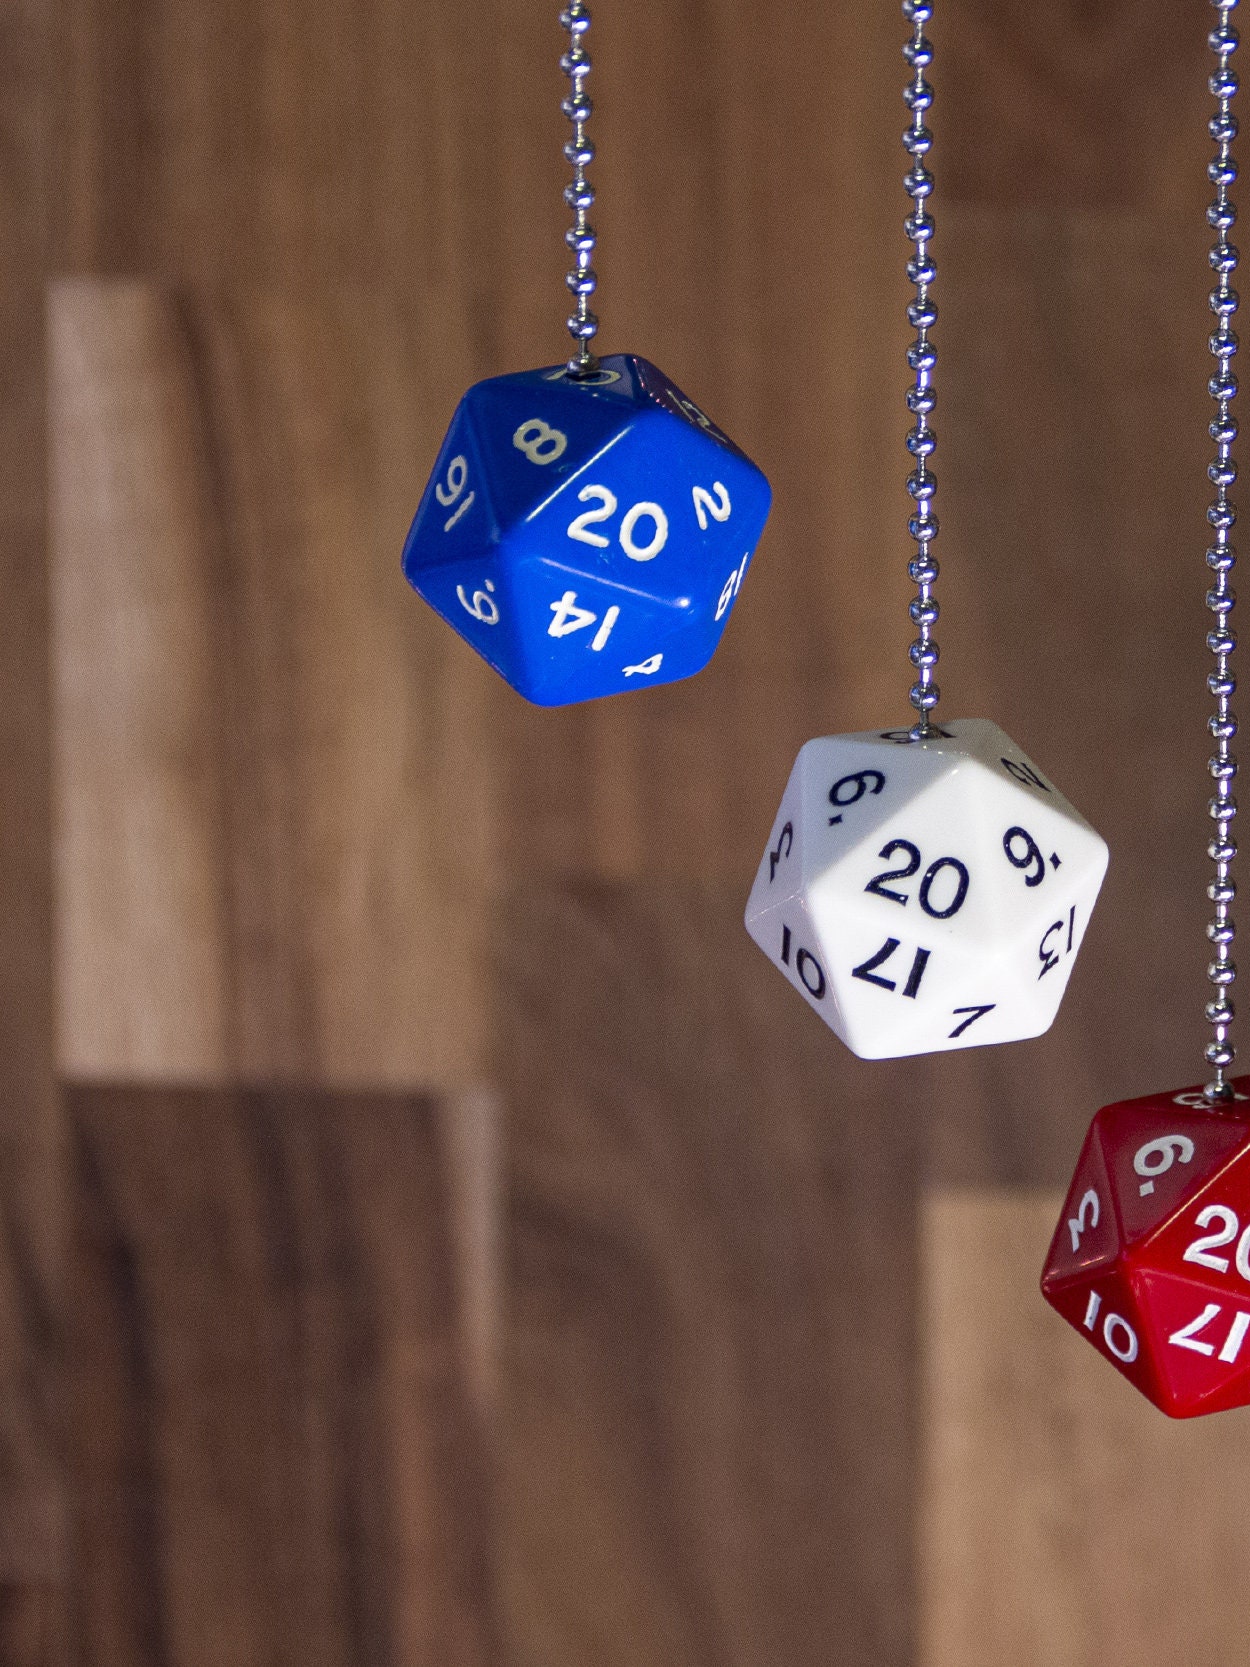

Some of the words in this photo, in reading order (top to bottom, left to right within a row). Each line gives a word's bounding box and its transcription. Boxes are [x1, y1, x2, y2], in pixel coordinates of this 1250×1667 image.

[513, 418, 567, 465] 8
[435, 455, 475, 532] 16
[567, 484, 668, 561] 20
[692, 481, 731, 530] 2
[548, 591, 620, 651] 14
[622, 653, 663, 677] 4
[769, 821, 793, 884] 3
[864, 839, 970, 919] 20
[781, 924, 825, 1000] 10
[851, 937, 931, 999] 17
[1037, 905, 1076, 981] 13
[948, 1004, 996, 1038] 7
[1068, 1189, 1100, 1252] 3
[1083, 1290, 1138, 1362] 10
